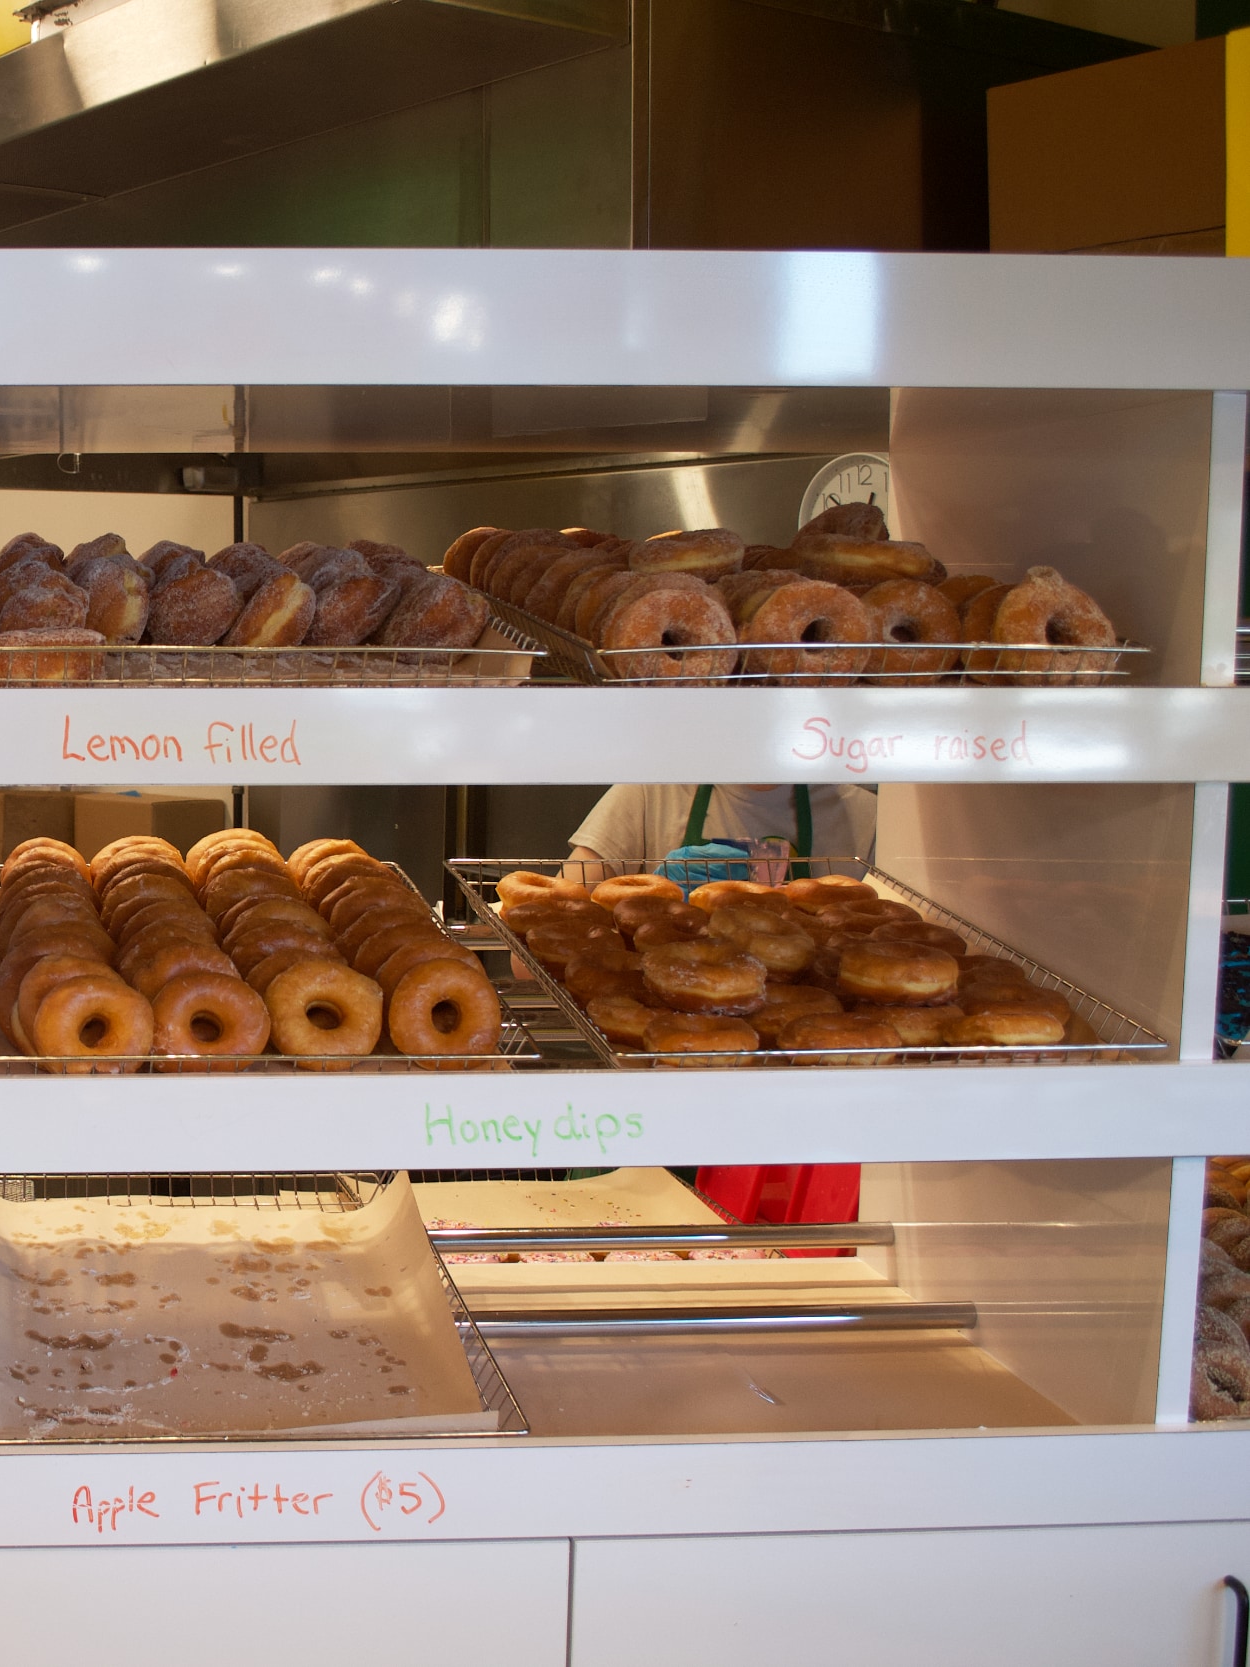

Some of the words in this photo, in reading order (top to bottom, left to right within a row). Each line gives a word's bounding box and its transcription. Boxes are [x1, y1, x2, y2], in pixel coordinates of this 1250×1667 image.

[839, 473, 851, 494] 11
[856, 464, 873, 486] 12
[63, 715, 183, 762] Lemon
[203, 719, 301, 765] filled
[792, 717, 902, 773] Sugar
[934, 719, 1033, 765] raised
[425, 1102, 541, 1157] Honey
[553, 1101, 643, 1154] dips
[72, 1485, 159, 1533] Apple
[193, 1481, 333, 1518] Fritter
[360, 1470, 446, 1531] ($5)
